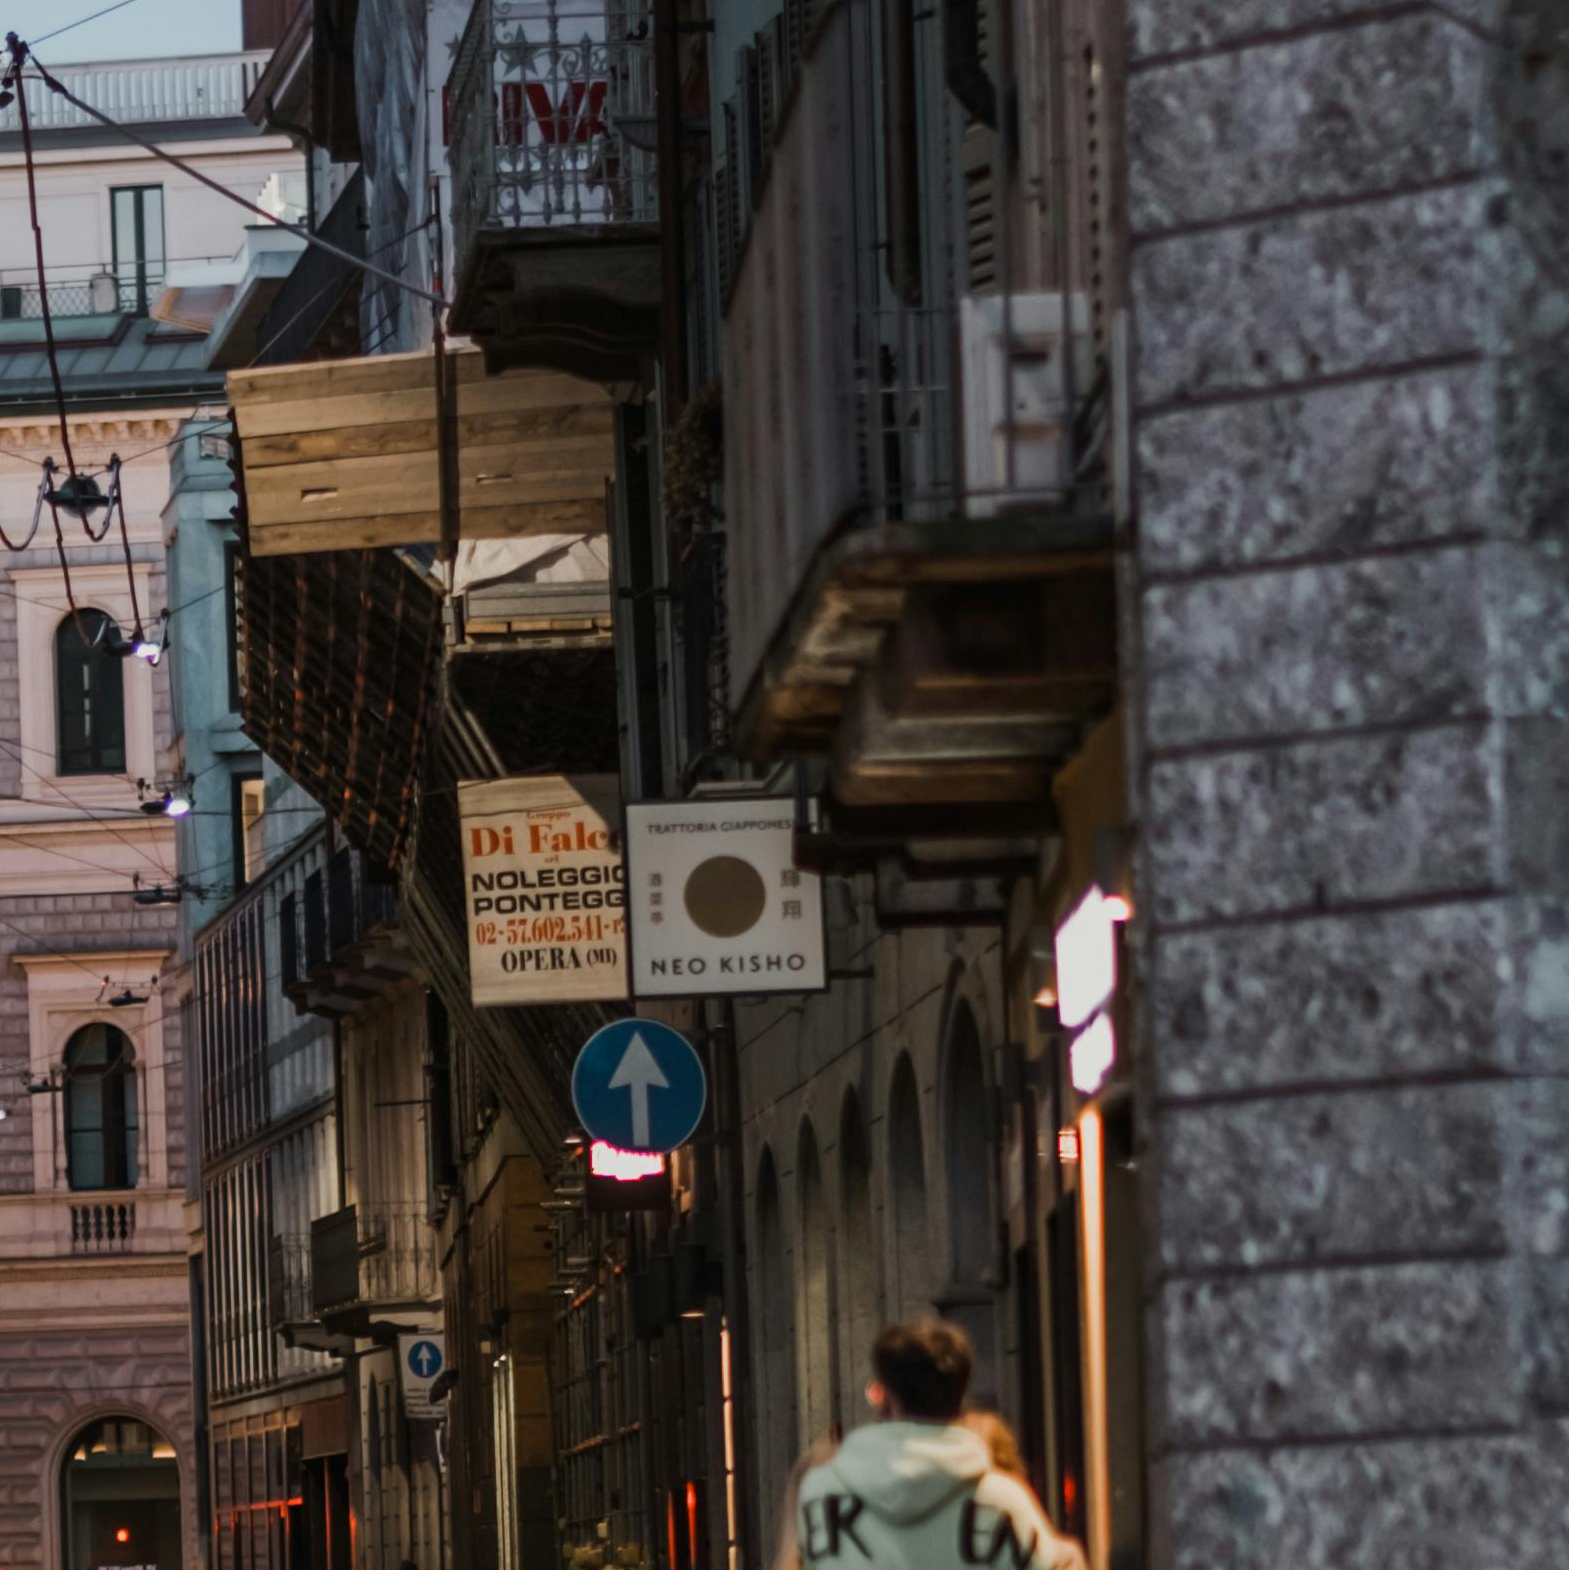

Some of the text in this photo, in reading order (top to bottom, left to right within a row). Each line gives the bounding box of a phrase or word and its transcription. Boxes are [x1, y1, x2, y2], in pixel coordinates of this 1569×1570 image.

[647, 821, 717, 835] TRATTORIA
[470, 826, 515, 857] Di
[501, 947, 617, 973] OPERA (MI)
[651, 954, 805, 976] NEO KISHO
